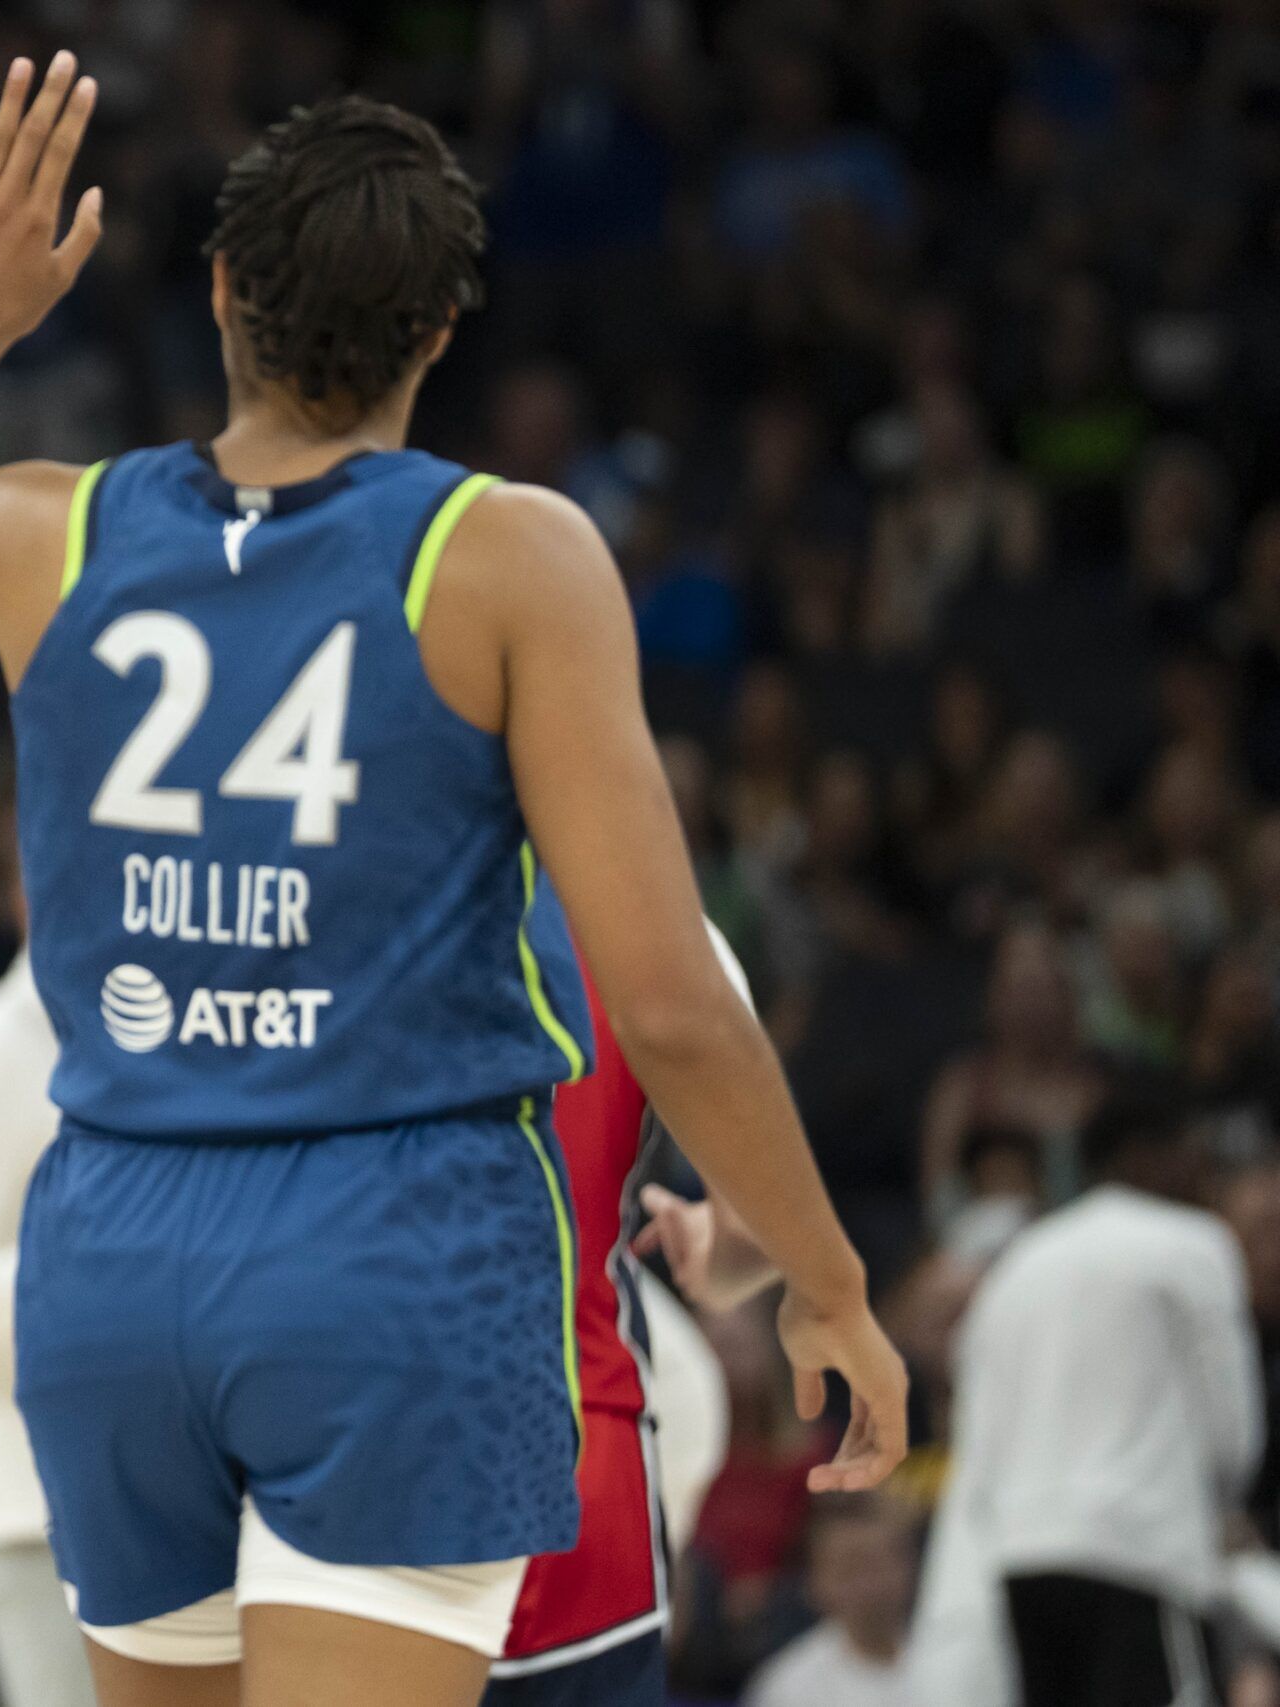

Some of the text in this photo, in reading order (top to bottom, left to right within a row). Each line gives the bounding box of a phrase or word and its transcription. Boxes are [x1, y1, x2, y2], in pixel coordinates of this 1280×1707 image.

[90, 610, 361, 846] 24
[123, 853, 310, 949] COLLIER
[179, 987, 333, 1048] AT&T
